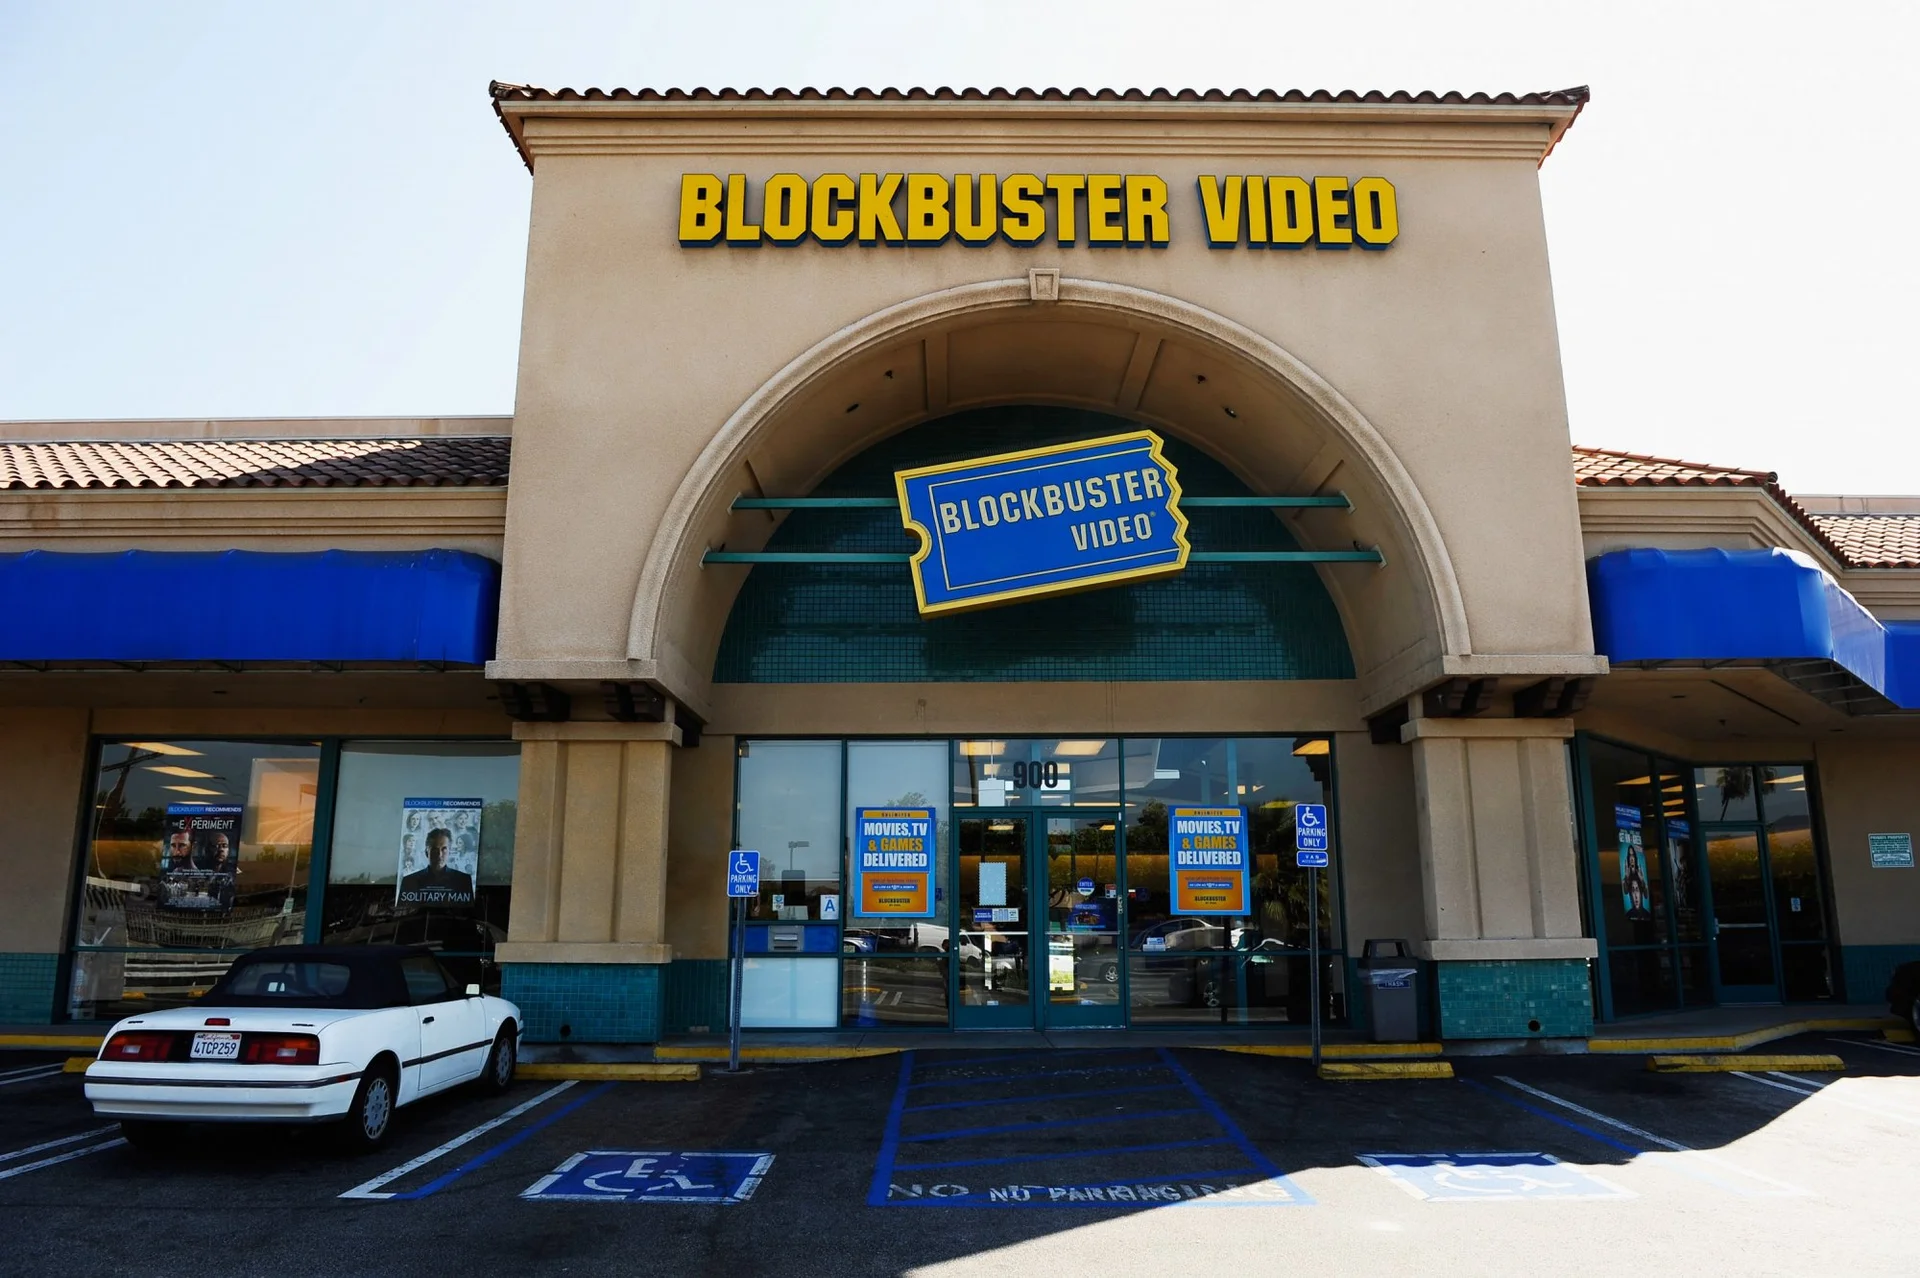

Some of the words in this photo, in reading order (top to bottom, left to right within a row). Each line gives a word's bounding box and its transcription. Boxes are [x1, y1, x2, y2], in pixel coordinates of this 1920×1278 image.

[678, 173, 1170, 247] BLOCKBUSTER
[1196, 175, 1399, 249] VIDEO
[939, 467, 1164, 534] BLOCKBUSTER
[1070, 512, 1152, 551] VIDEO
[1013, 761, 1058, 788] 900
[179, 818, 234, 830] EXPERIMENT
[1298, 828, 1326, 837] PARKING
[868, 839, 877, 851] &
[881, 838, 923, 851] GAMES
[1182, 837, 1191, 849] &
[1194, 836, 1236, 849] GAMES
[1303, 838, 1321, 847] ONLY
[863, 853, 928, 867] DELIVERED
[1177, 851, 1241, 865] DELIVERED
[730, 874, 757, 883] PARKING
[735, 884, 752, 894] ONLY
[401, 892, 446, 902] SOLITARY
[447, 892, 471, 902] MAN
[824, 899, 835, 911] A
[194, 1042, 237, 1055] 4TCP259
[887, 1184, 969, 1198] NO
